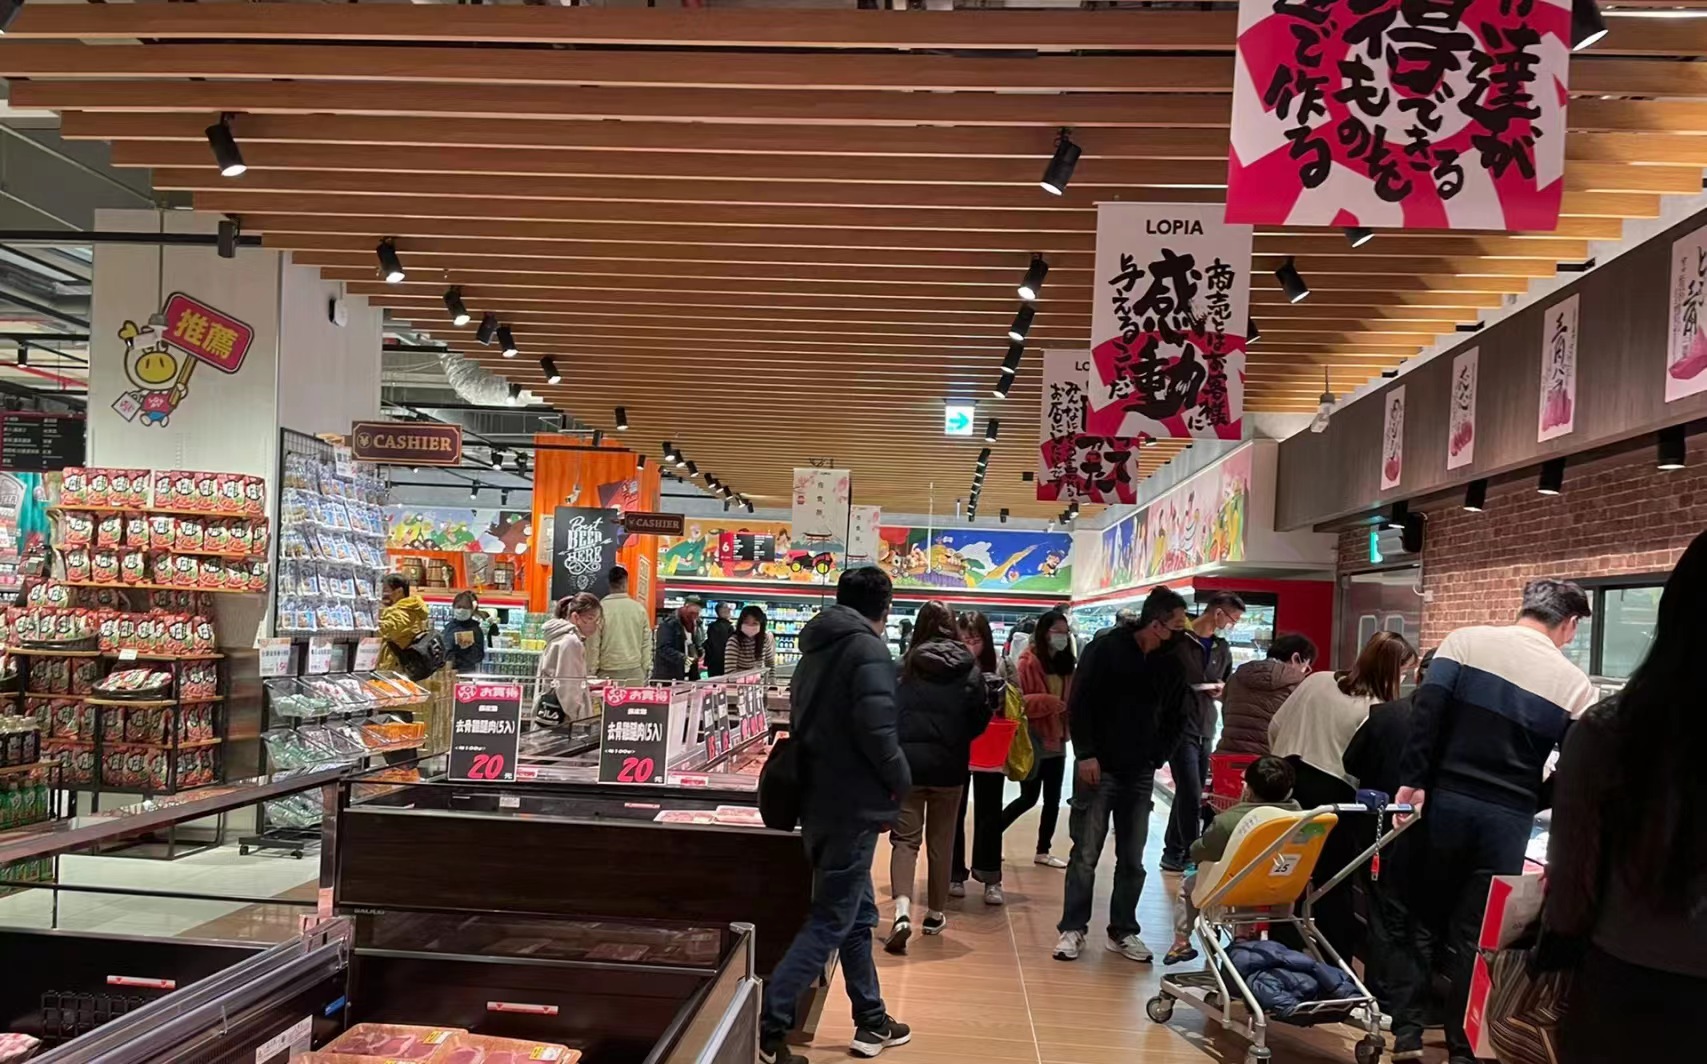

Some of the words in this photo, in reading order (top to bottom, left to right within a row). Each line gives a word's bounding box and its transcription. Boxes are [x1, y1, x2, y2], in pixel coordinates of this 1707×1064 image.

[1145, 219, 1204, 236] LOPIA
[173, 307, 240, 360] 推薦
[373, 434, 453, 452] CASHIER
[568, 515, 604, 531] Best
[636, 518, 680, 529] CASHIER
[567, 529, 603, 551] BEER
[722, 541, 730, 553] 6
[567, 545, 603, 563] HERE
[467, 752, 505, 779] 20
[616, 756, 655, 783] 20
